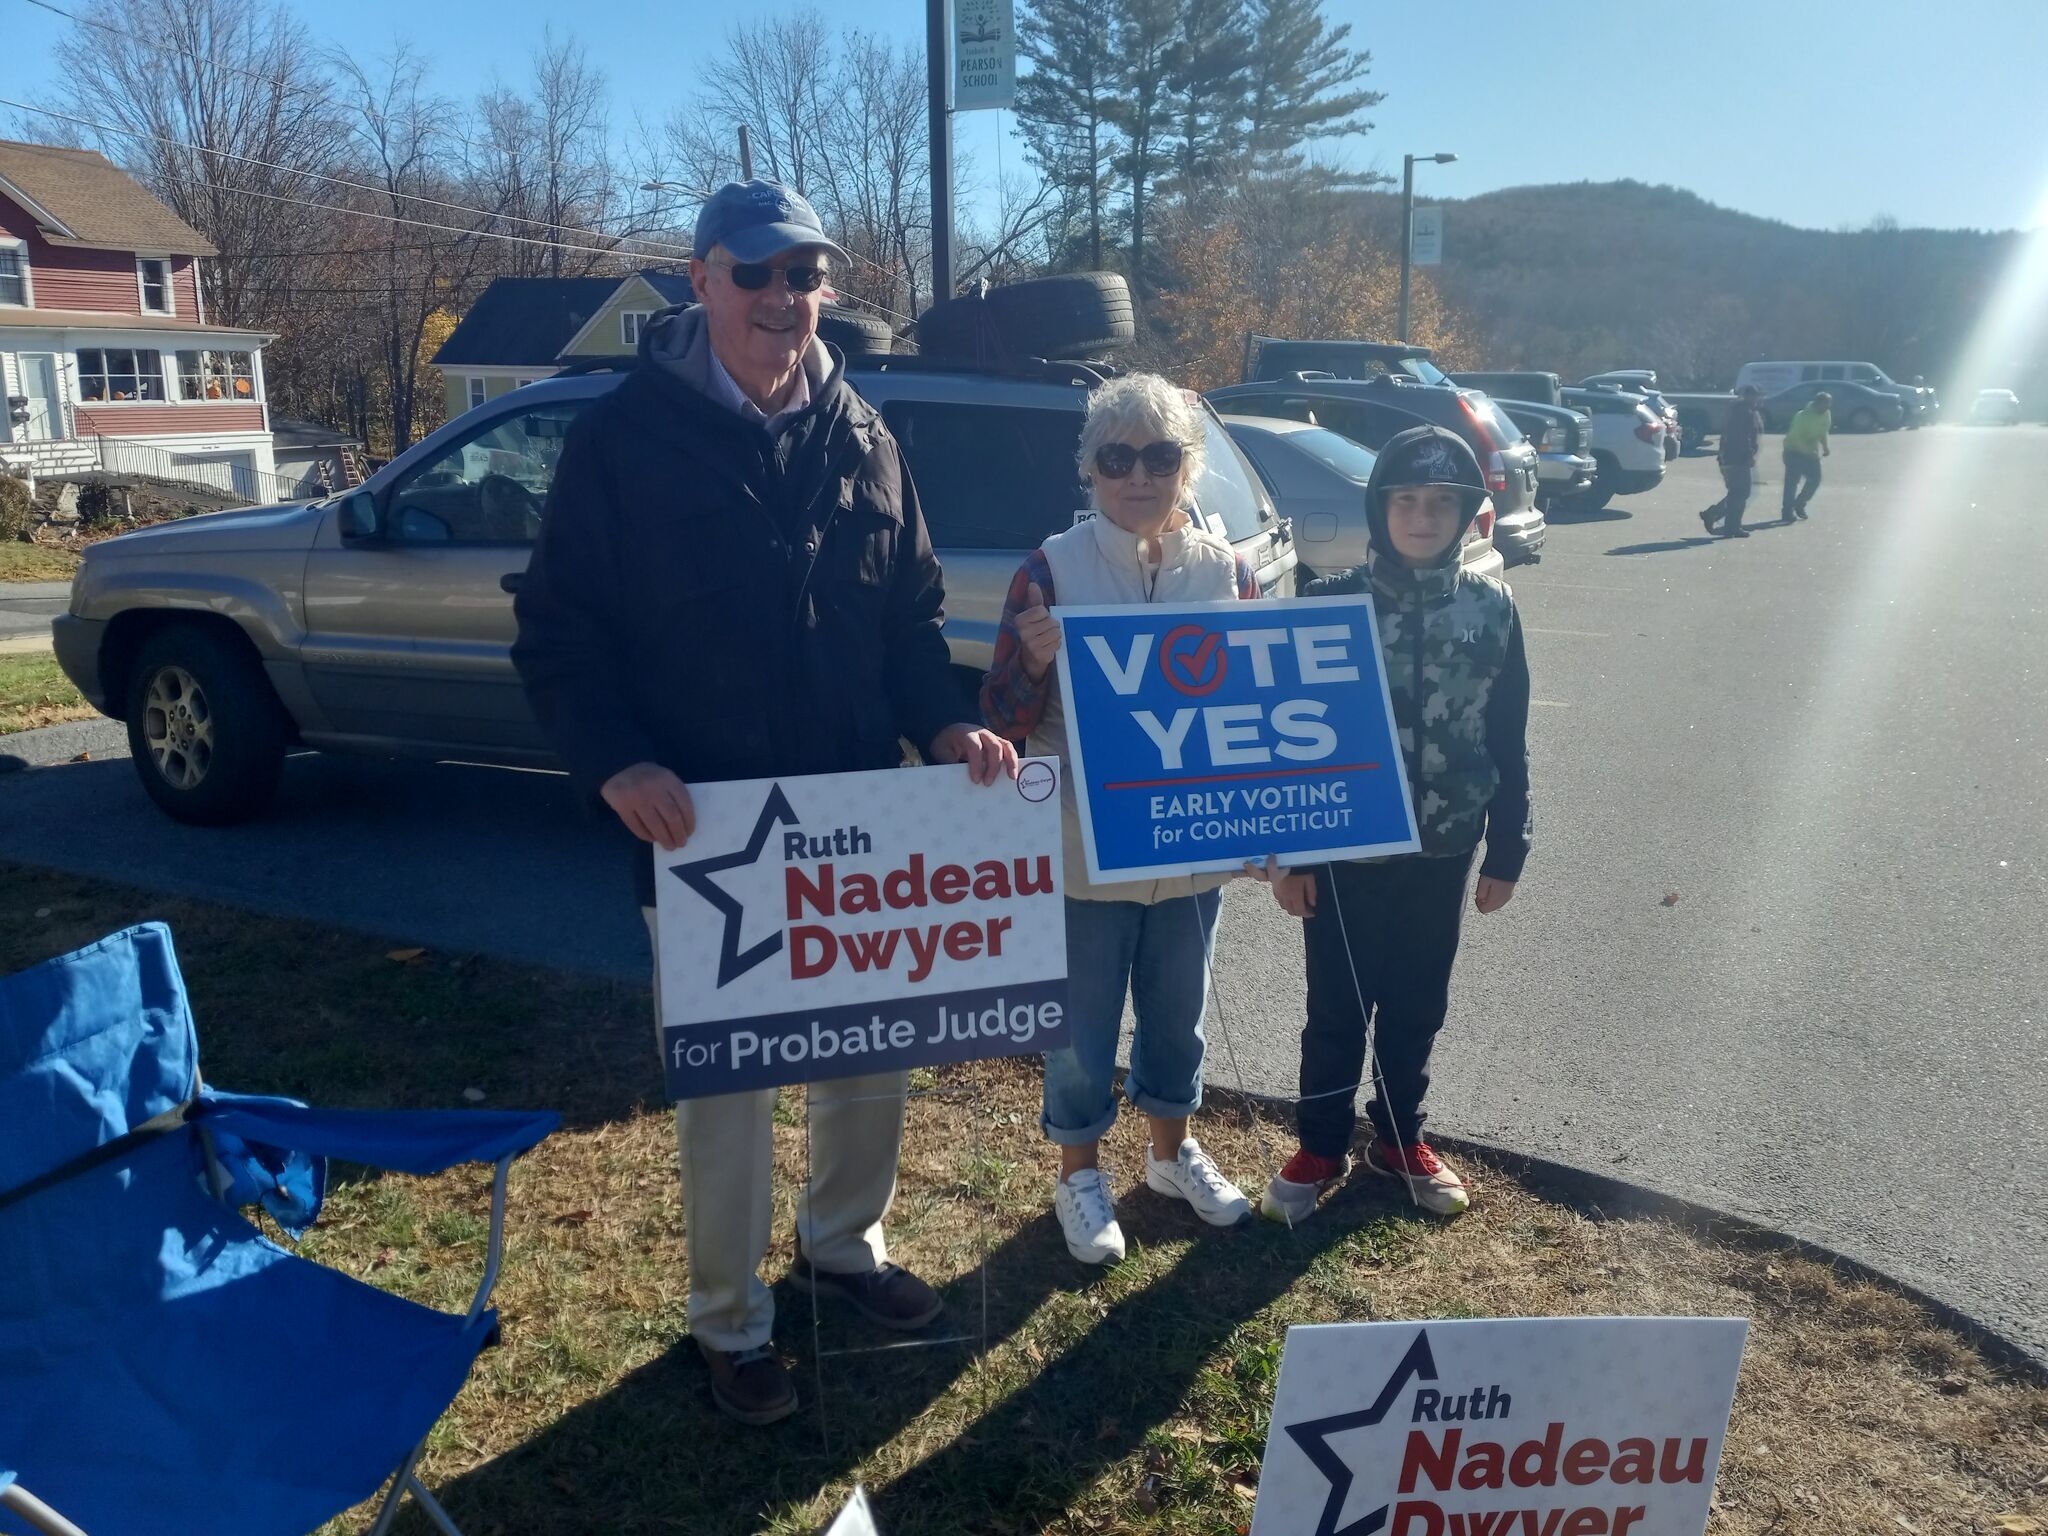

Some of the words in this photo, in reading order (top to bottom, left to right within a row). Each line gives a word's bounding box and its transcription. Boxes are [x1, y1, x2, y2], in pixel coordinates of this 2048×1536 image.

[961, 57, 1002, 71] PEARSON
[962, 74, 999, 88] SCHOOL
[1083, 624, 1361, 697] VOTE
[1130, 699, 1338, 770] YES
[1150, 790, 1237, 820] EARLY
[1239, 781, 1349, 811] VOTING
[784, 826, 873, 862] Ruth
[1152, 824, 1184, 850] for
[1189, 808, 1353, 841] CONNECTICUT
[785, 853, 1054, 921] Nadeau
[789, 914, 1013, 984] Dwyer
[671, 1037, 723, 1069] for
[729, 1014, 916, 1070] Probate
[927, 998, 1064, 1044] Judge
[1411, 1384, 1513, 1424] Ruth
[1396, 1421, 1709, 1494] Nadeau
